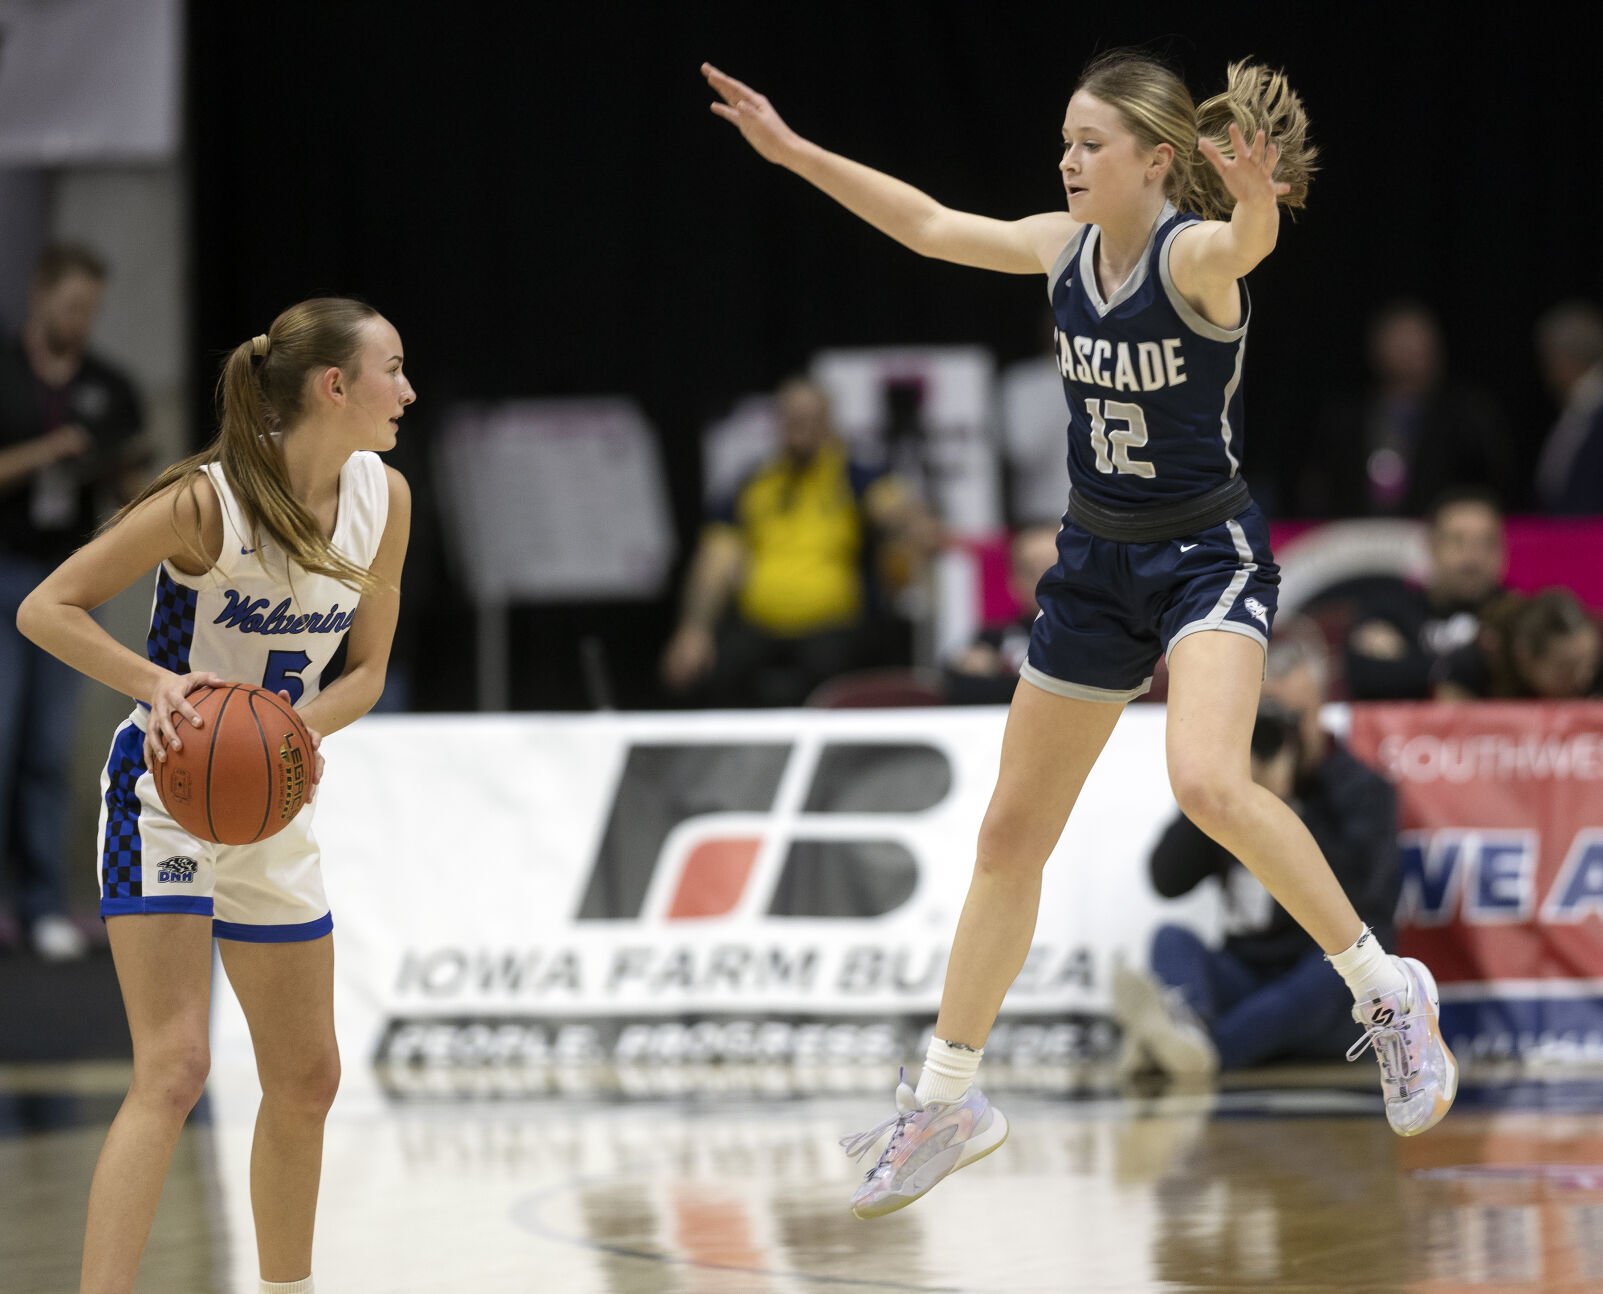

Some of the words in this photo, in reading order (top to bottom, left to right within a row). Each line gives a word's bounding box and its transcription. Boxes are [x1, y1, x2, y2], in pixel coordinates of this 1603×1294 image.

[1085, 398, 1156, 478] 12
[262, 649, 312, 707] 5
[158, 870, 193, 883] DNH
[397, 946, 582, 996] IOWA
[604, 944, 819, 996] FARM
